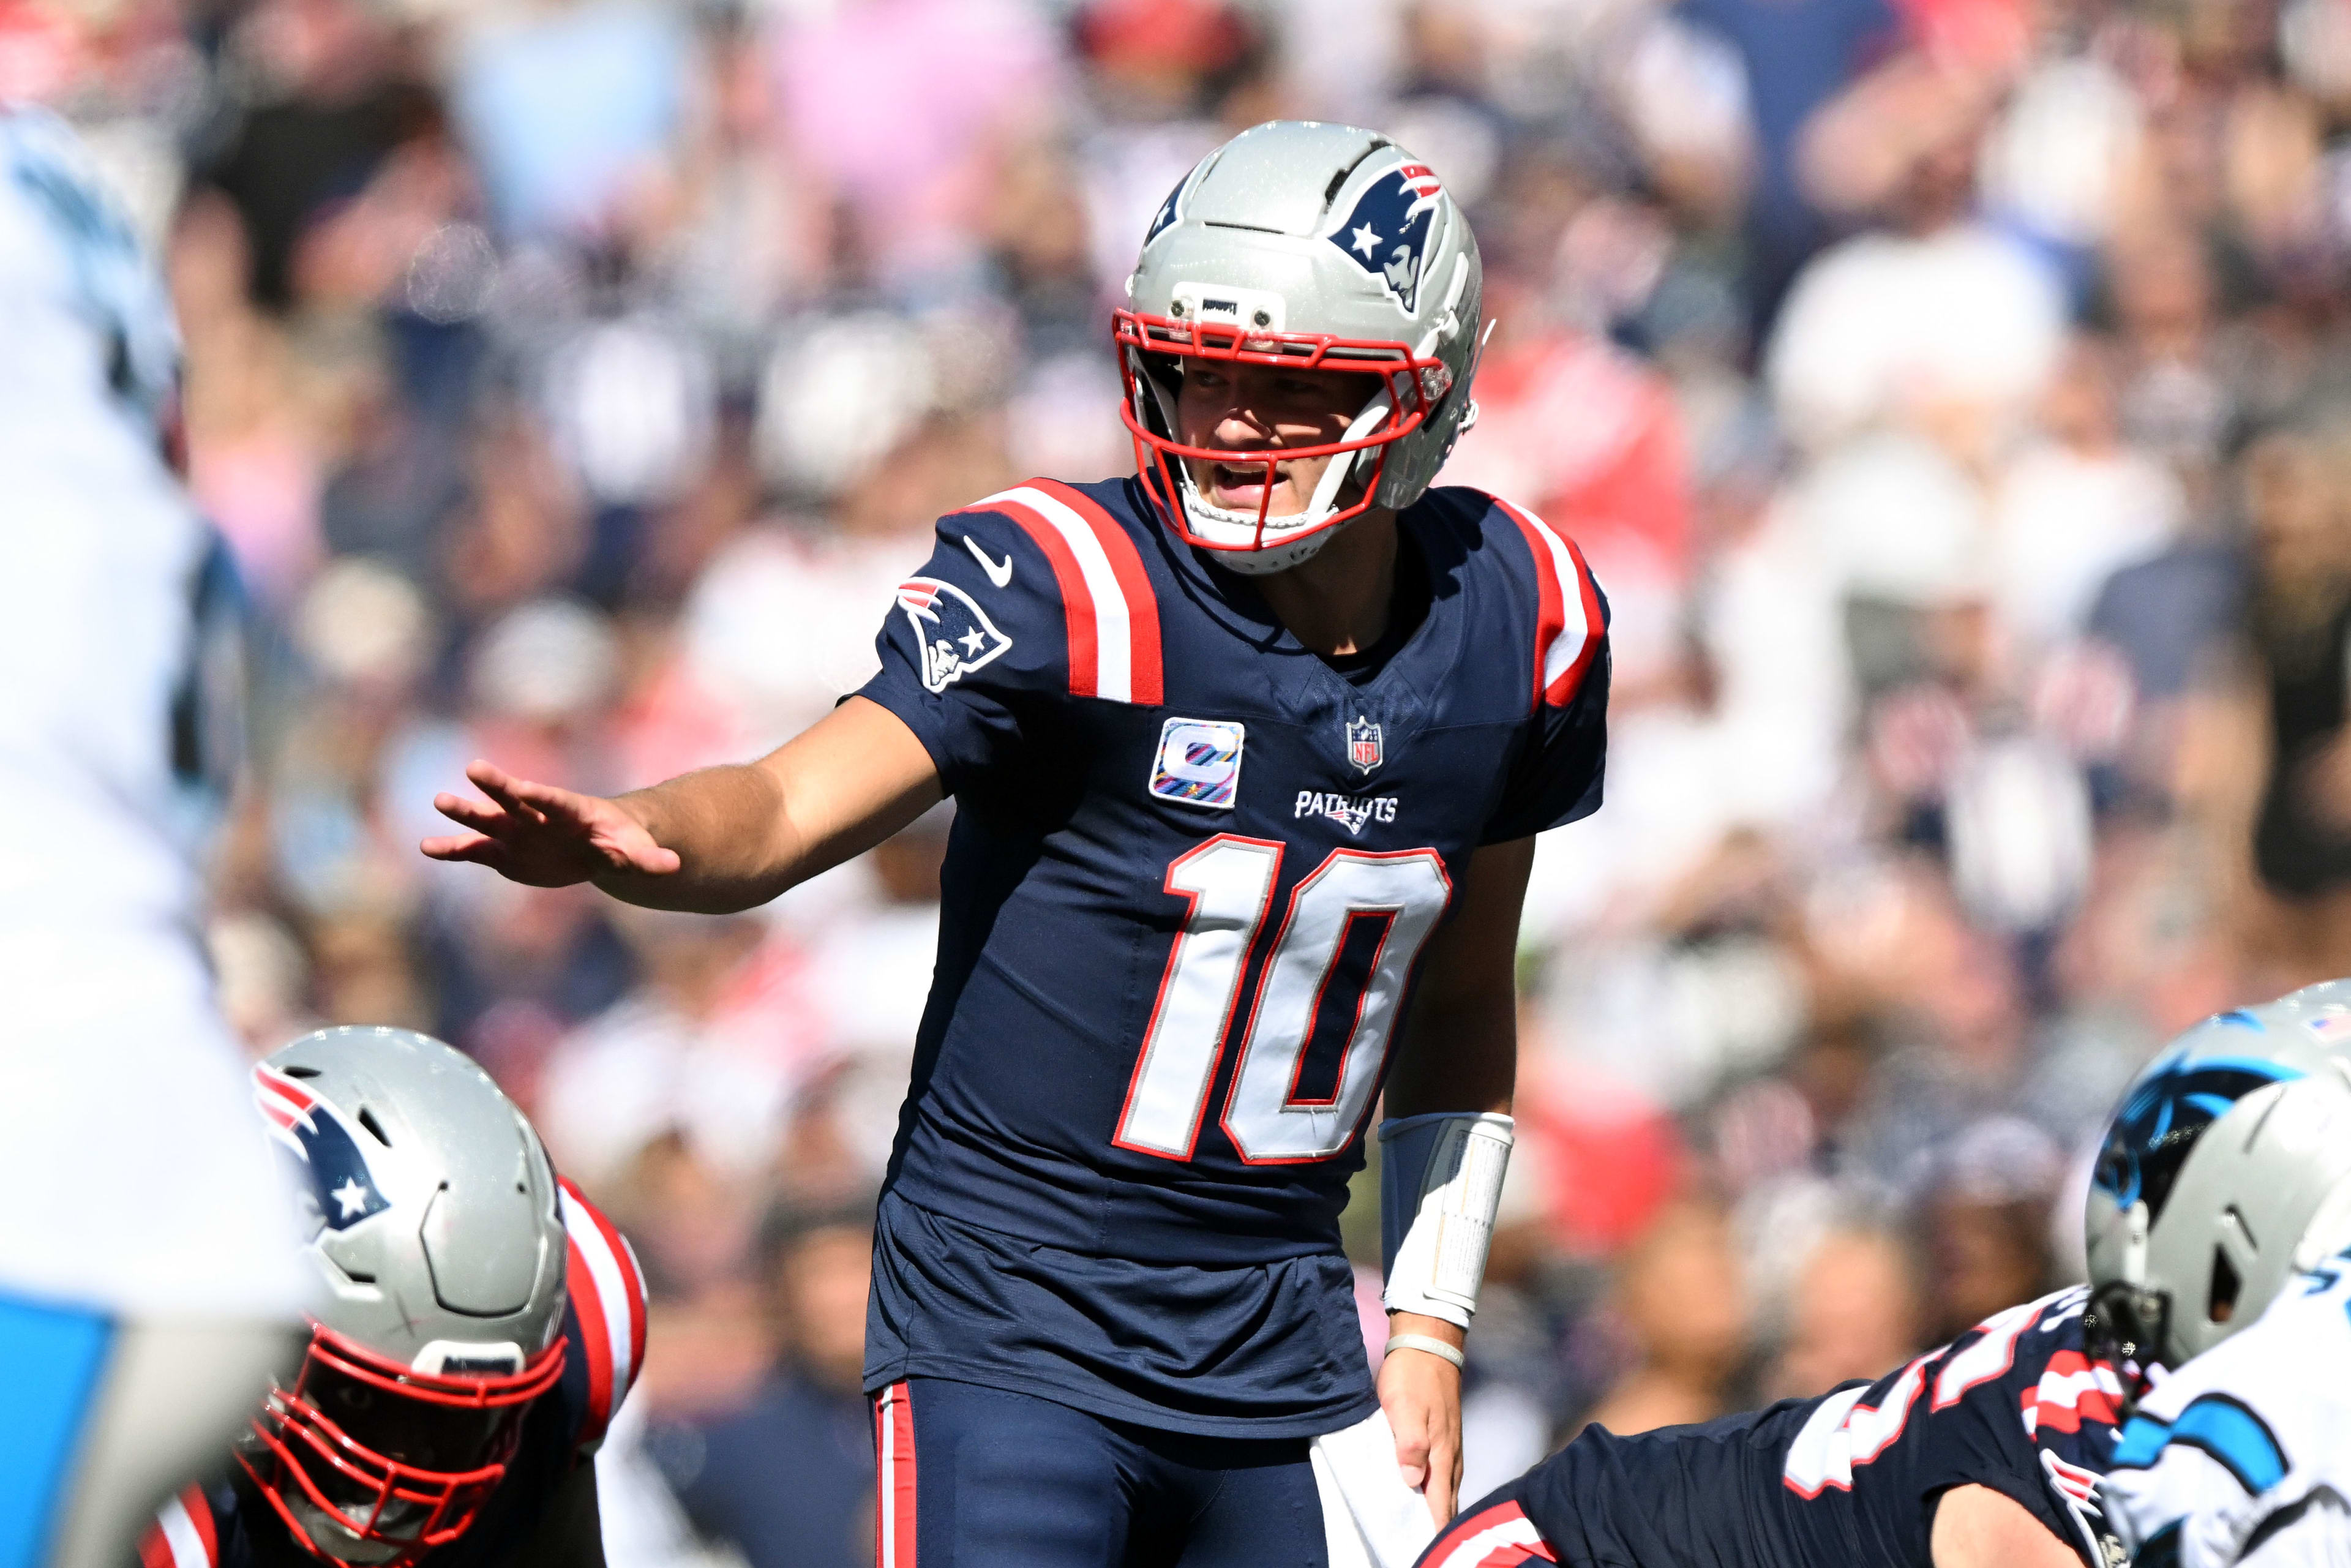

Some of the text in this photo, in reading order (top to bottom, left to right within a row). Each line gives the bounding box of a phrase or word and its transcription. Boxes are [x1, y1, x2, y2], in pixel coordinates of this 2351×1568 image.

[1163, 725, 1237, 782] C
[1354, 742, 1379, 764] NFL
[1294, 790, 1398, 823] PATRIOTS
[1111, 831, 1453, 1166] 10
